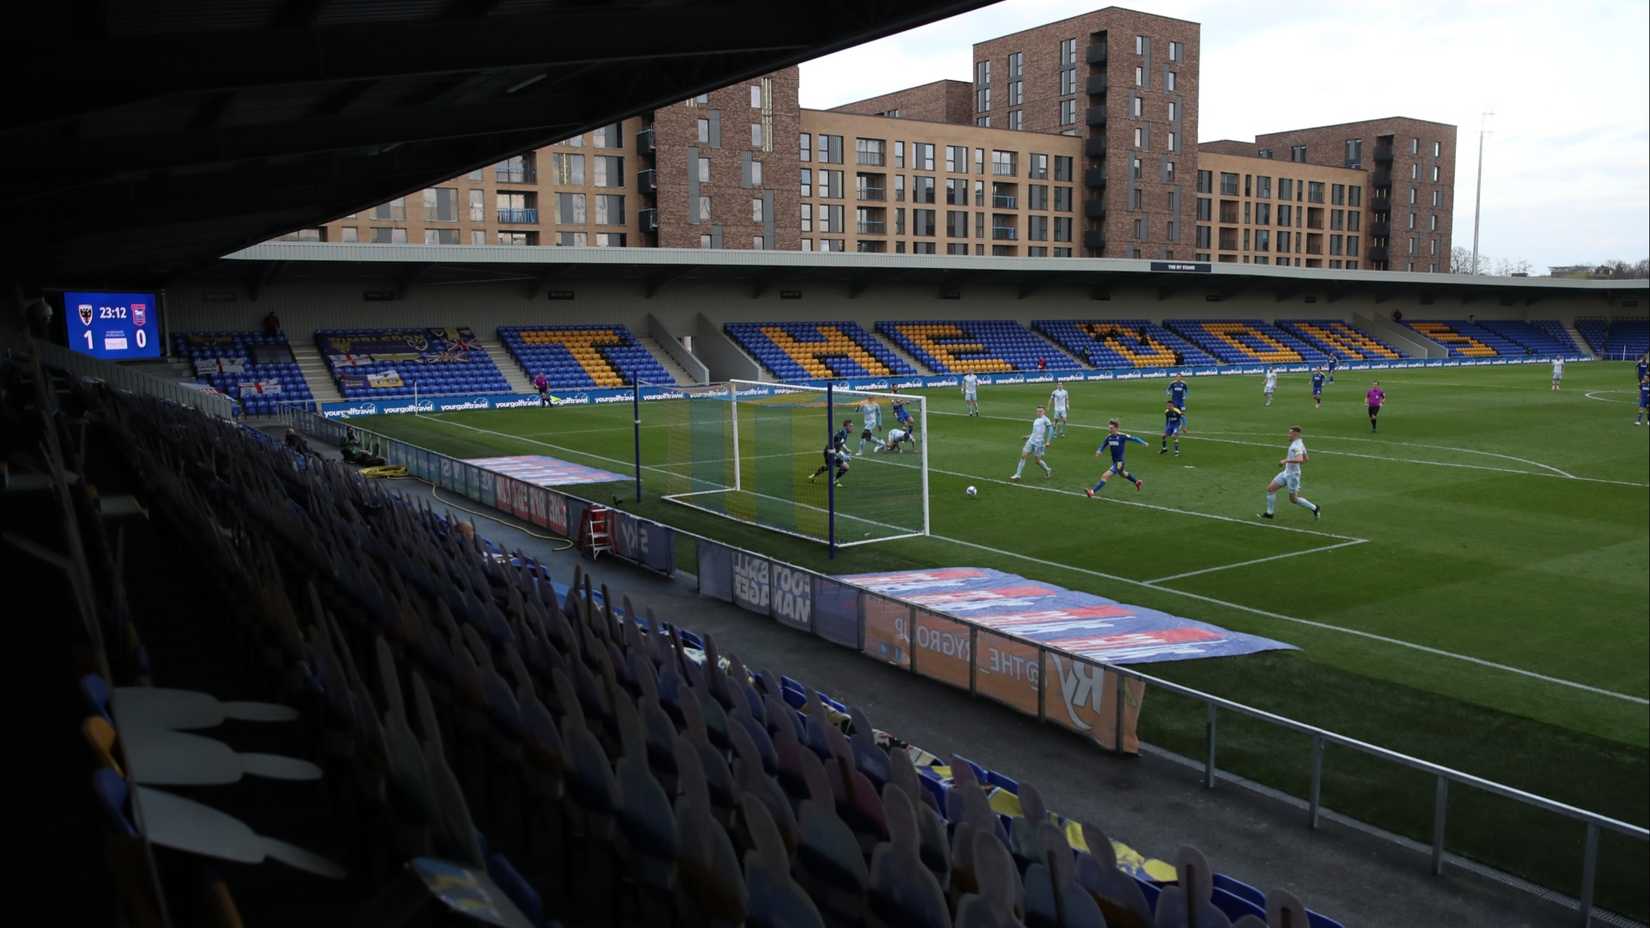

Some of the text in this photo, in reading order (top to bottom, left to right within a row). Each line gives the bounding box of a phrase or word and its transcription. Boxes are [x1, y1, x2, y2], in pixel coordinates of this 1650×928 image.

[99, 306, 127, 319] 23:12
[84, 330, 94, 350] 1
[136, 329, 147, 348] 0
